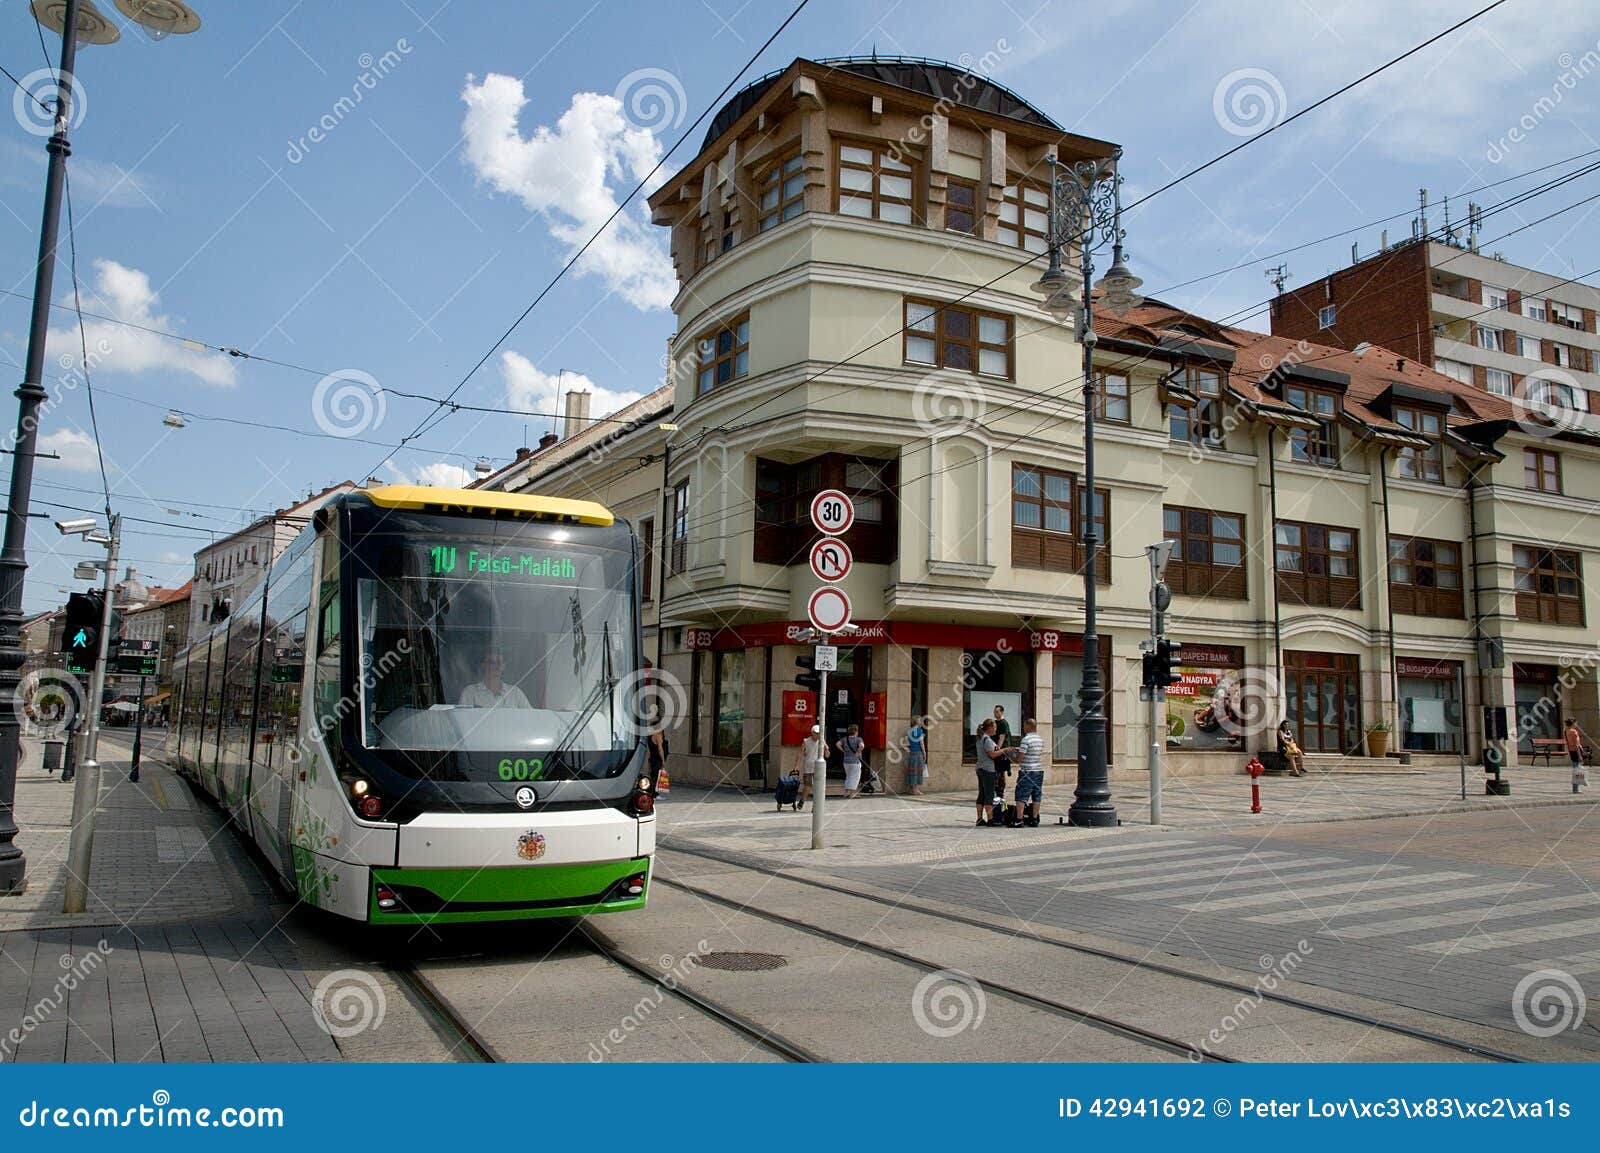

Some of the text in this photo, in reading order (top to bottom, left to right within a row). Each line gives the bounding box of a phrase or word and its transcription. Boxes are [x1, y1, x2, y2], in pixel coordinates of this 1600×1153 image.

[823, 501, 842, 522] 30
[855, 627, 884, 637] BANK
[1186, 675, 1213, 685] NAGYRA
[498, 759, 544, 781] 602
